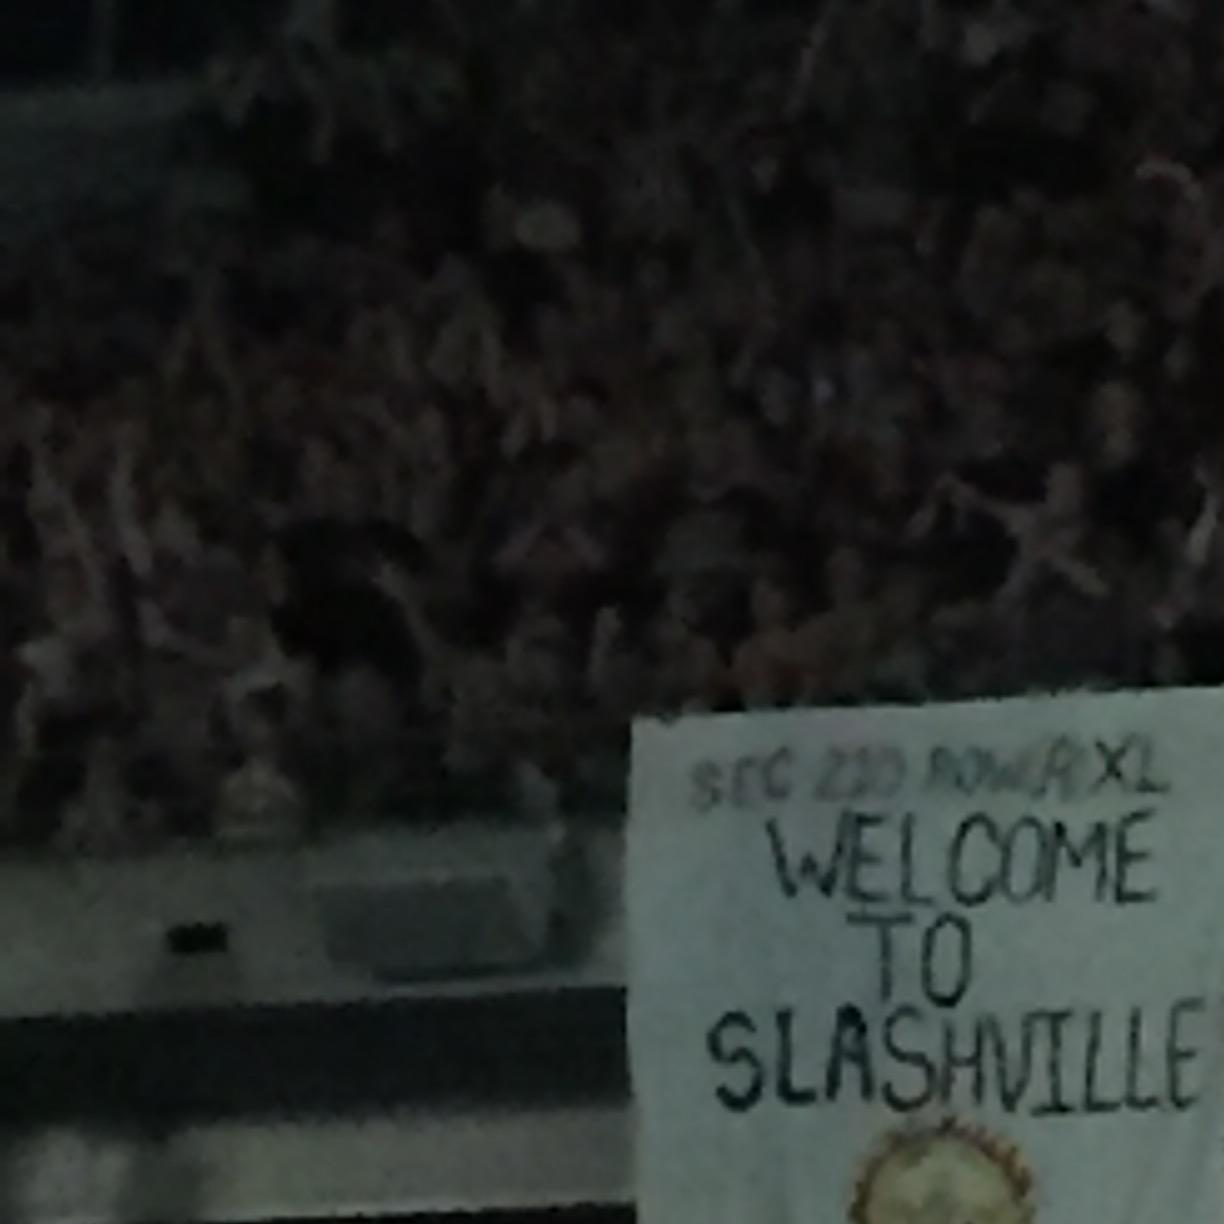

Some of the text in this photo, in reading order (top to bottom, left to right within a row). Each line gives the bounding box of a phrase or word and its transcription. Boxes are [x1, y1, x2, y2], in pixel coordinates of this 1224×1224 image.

[764, 808, 1159, 907] WELCOME
[845, 911, 974, 1007] TO
[705, 997, 1207, 1118] SLASHVILLE
